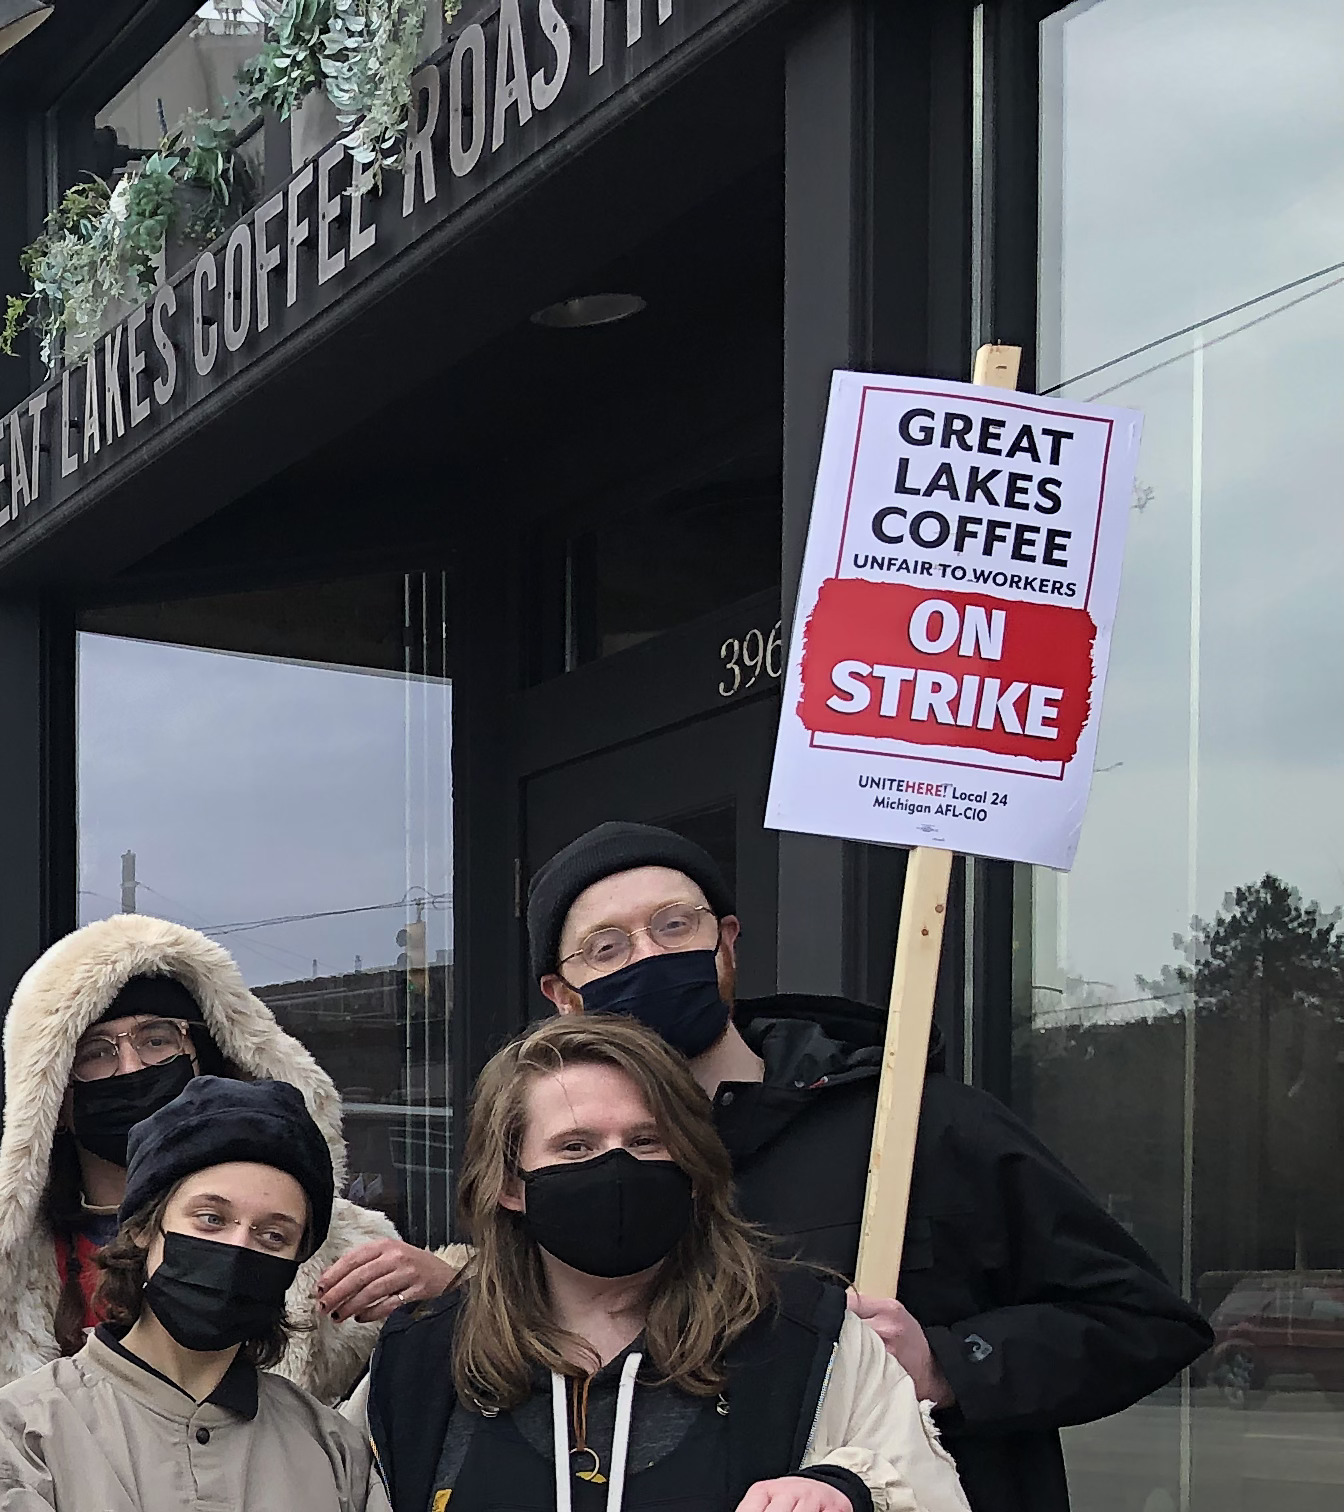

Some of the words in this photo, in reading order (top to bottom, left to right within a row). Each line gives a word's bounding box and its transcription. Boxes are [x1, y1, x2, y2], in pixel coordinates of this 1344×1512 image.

[61, 282, 177, 478] LAKES
[403, 0, 672, 218] ROAS
[899, 408, 1074, 466] GREAT
[895, 457, 1062, 514] LAKES
[870, 507, 1072, 573] COFFEE
[854, 554, 932, 576] UNFAIR
[938, 564, 966, 580] TO
[973, 569, 1076, 597] WORKERS
[910, 600, 1006, 660] ON
[827, 661, 1063, 739] STRIKE
[859, 775, 952, 797] UNITEHERE!
[952, 787, 987, 803] Local
[991, 793, 1007, 806] 24
[873, 797, 930, 814] Michigan
[935, 804, 987, 821] AFL-CIO
